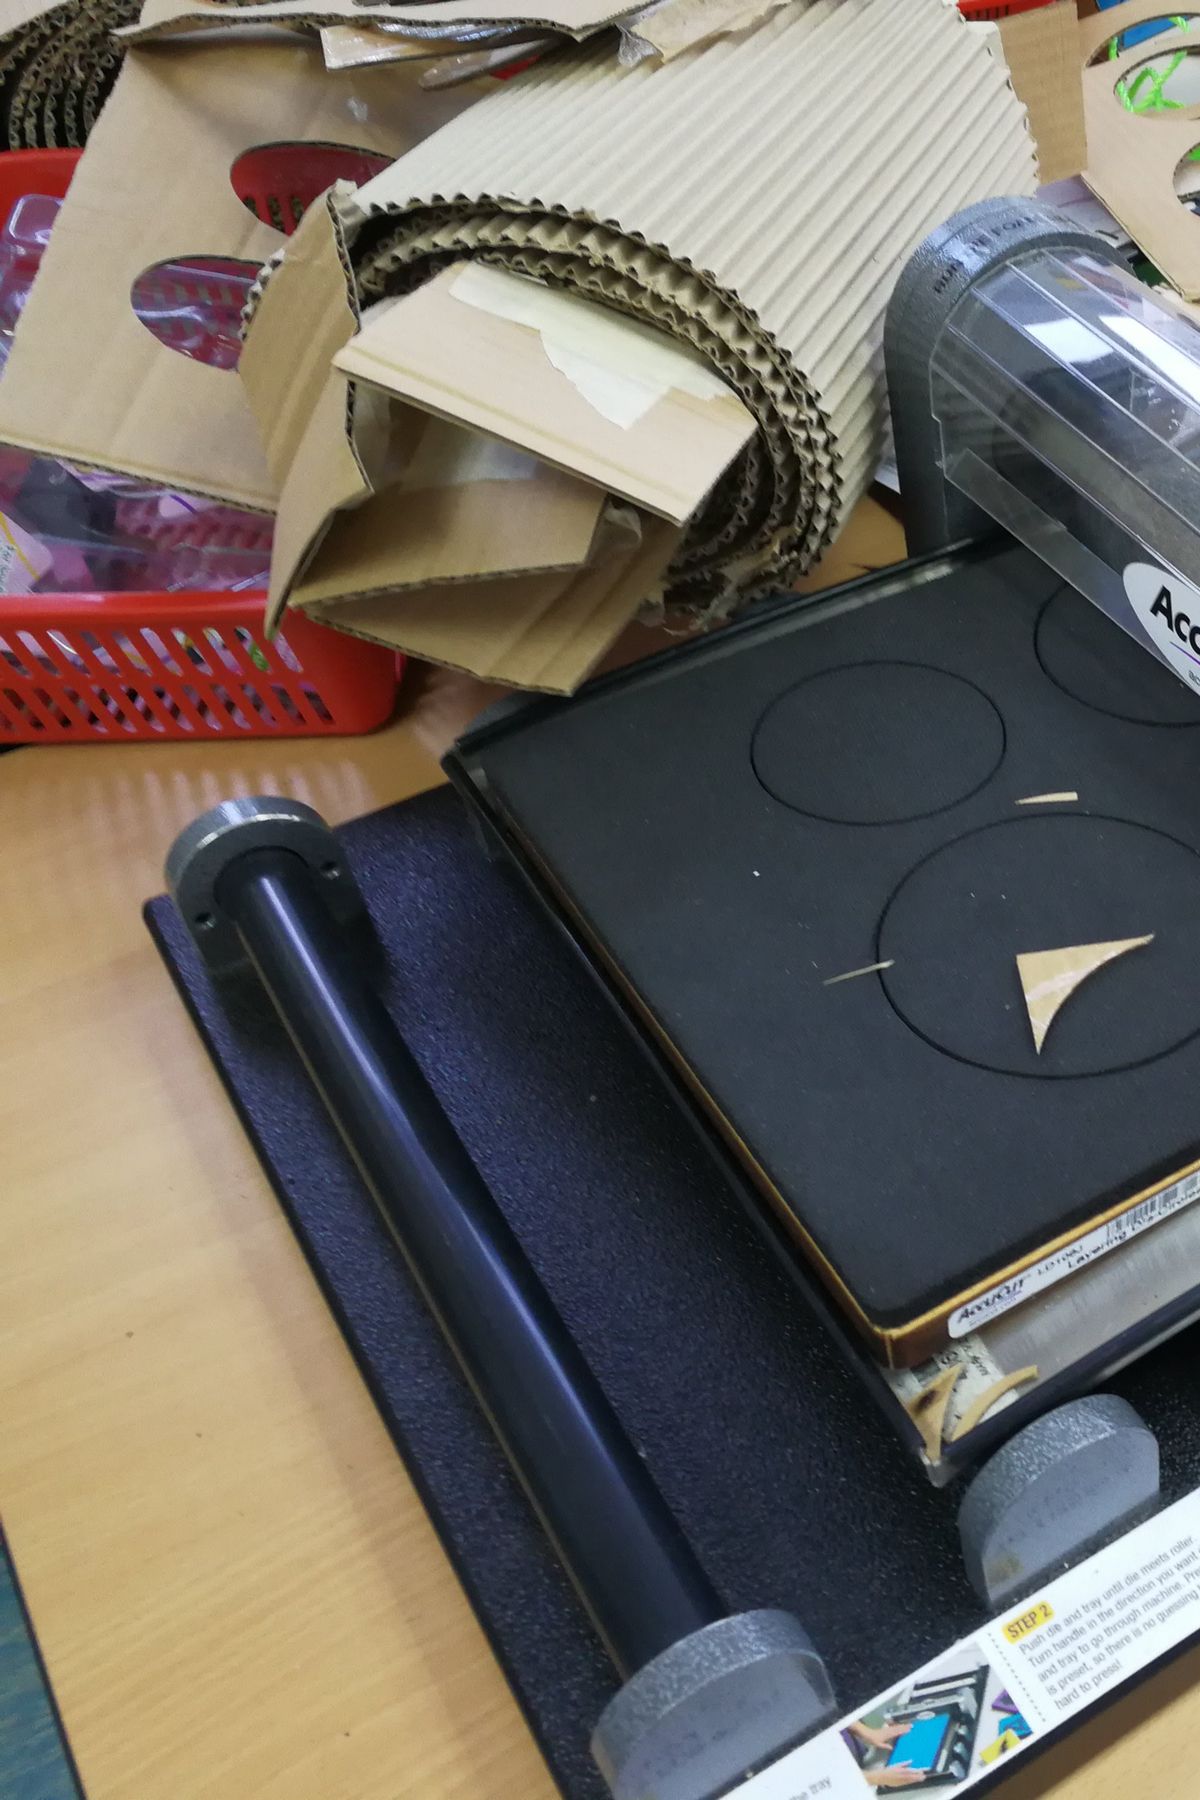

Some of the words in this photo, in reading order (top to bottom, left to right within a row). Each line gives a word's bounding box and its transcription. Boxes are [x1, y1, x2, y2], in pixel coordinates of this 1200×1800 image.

[1006, 1610, 1040, 1639] STEP
[1037, 1602, 1051, 1618] 2
[1018, 1632, 1046, 1656] Push
[1044, 1621, 1063, 1638] die
[1061, 1608, 1083, 1627] and
[1081, 1595, 1104, 1616] tray
[1100, 1580, 1125, 1601] until
[1123, 1570, 1141, 1587] die
[1139, 1551, 1171, 1577] meets
[1168, 1533, 1197, 1557] roller.
[1027, 1645, 1054, 1669] Turn
[1051, 1623, 1087, 1653] handle
[1084, 1616, 1098, 1631] in
[1096, 1605, 1115, 1623] the
[1113, 1577, 1157, 1612] direction
[1155, 1567, 1176, 1586] you
[1172, 1550, 1199, 1572] want
[1035, 1662, 1059, 1683] and
[1056, 1649, 1080, 1671] tray
[1077, 1641, 1091, 1655] to
[1089, 1633, 1106, 1649] go
[1102, 1606, 1143, 1640] through
[1140, 1578, 1185, 1613] machine.
[1044, 1682, 1058, 1697] is
[1056, 1660, 1094, 1691] preset,
[1091, 1651, 1107, 1666] so
[1104, 1632, 1133, 1657] there
[1130, 1625, 1143, 1639] is
[1141, 1617, 1157, 1632] no
[1154, 1588, 1200, 1625] guessing
[1053, 1686, 1080, 1710] hard
[1078, 1680, 1092, 1694] to
[1089, 1658, 1125, 1688] press!
